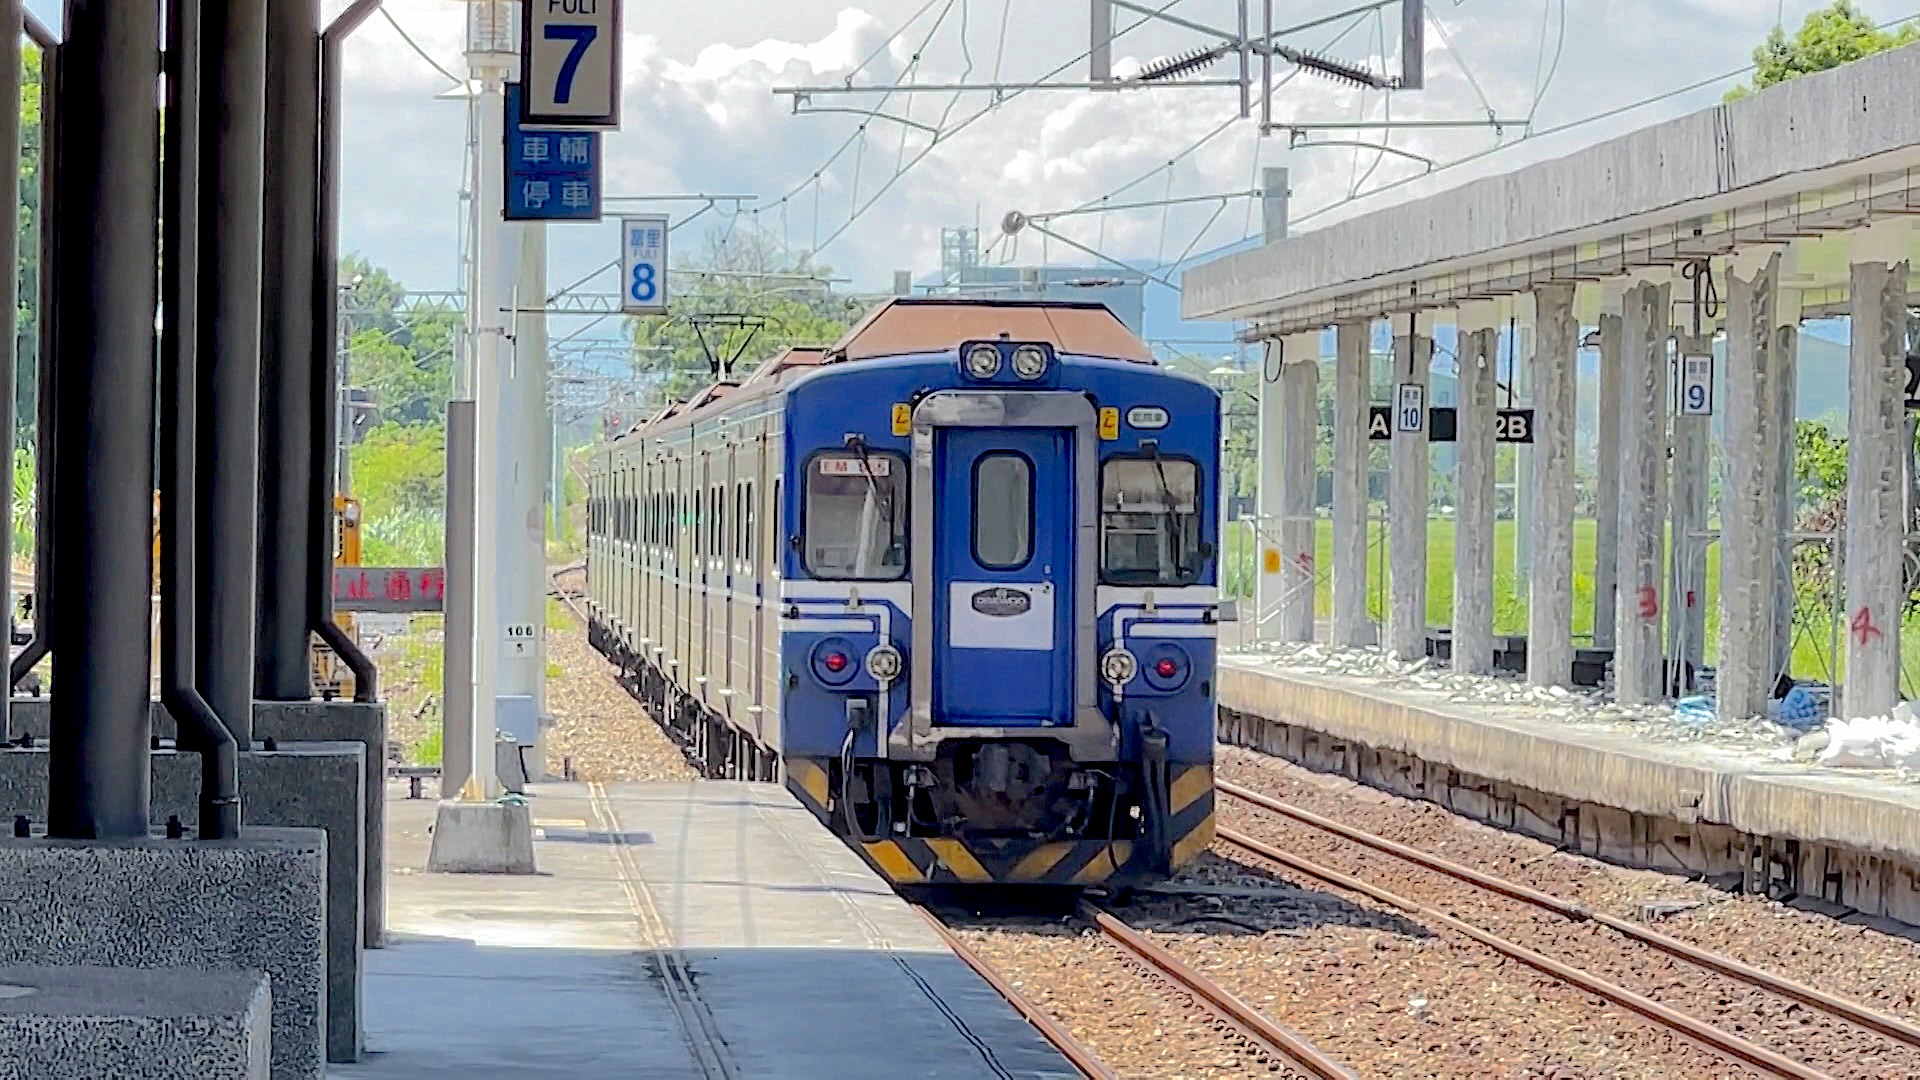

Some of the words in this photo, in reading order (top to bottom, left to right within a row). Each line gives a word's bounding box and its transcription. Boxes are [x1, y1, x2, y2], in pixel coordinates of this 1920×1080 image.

[543, 24, 598, 104] 7
[522, 136, 591, 165] 車輛
[522, 179, 592, 209] 停車
[631, 263, 657, 301] 8
[1684, 385, 1705, 410] 9
[1370, 413, 1389, 436] A
[1403, 407, 1418, 428] 10
[1496, 415, 1527, 439] 2B
[335, 570, 444, 601] 止通行
[1638, 584, 1658, 619] 3
[1852, 605, 1882, 646] 4
